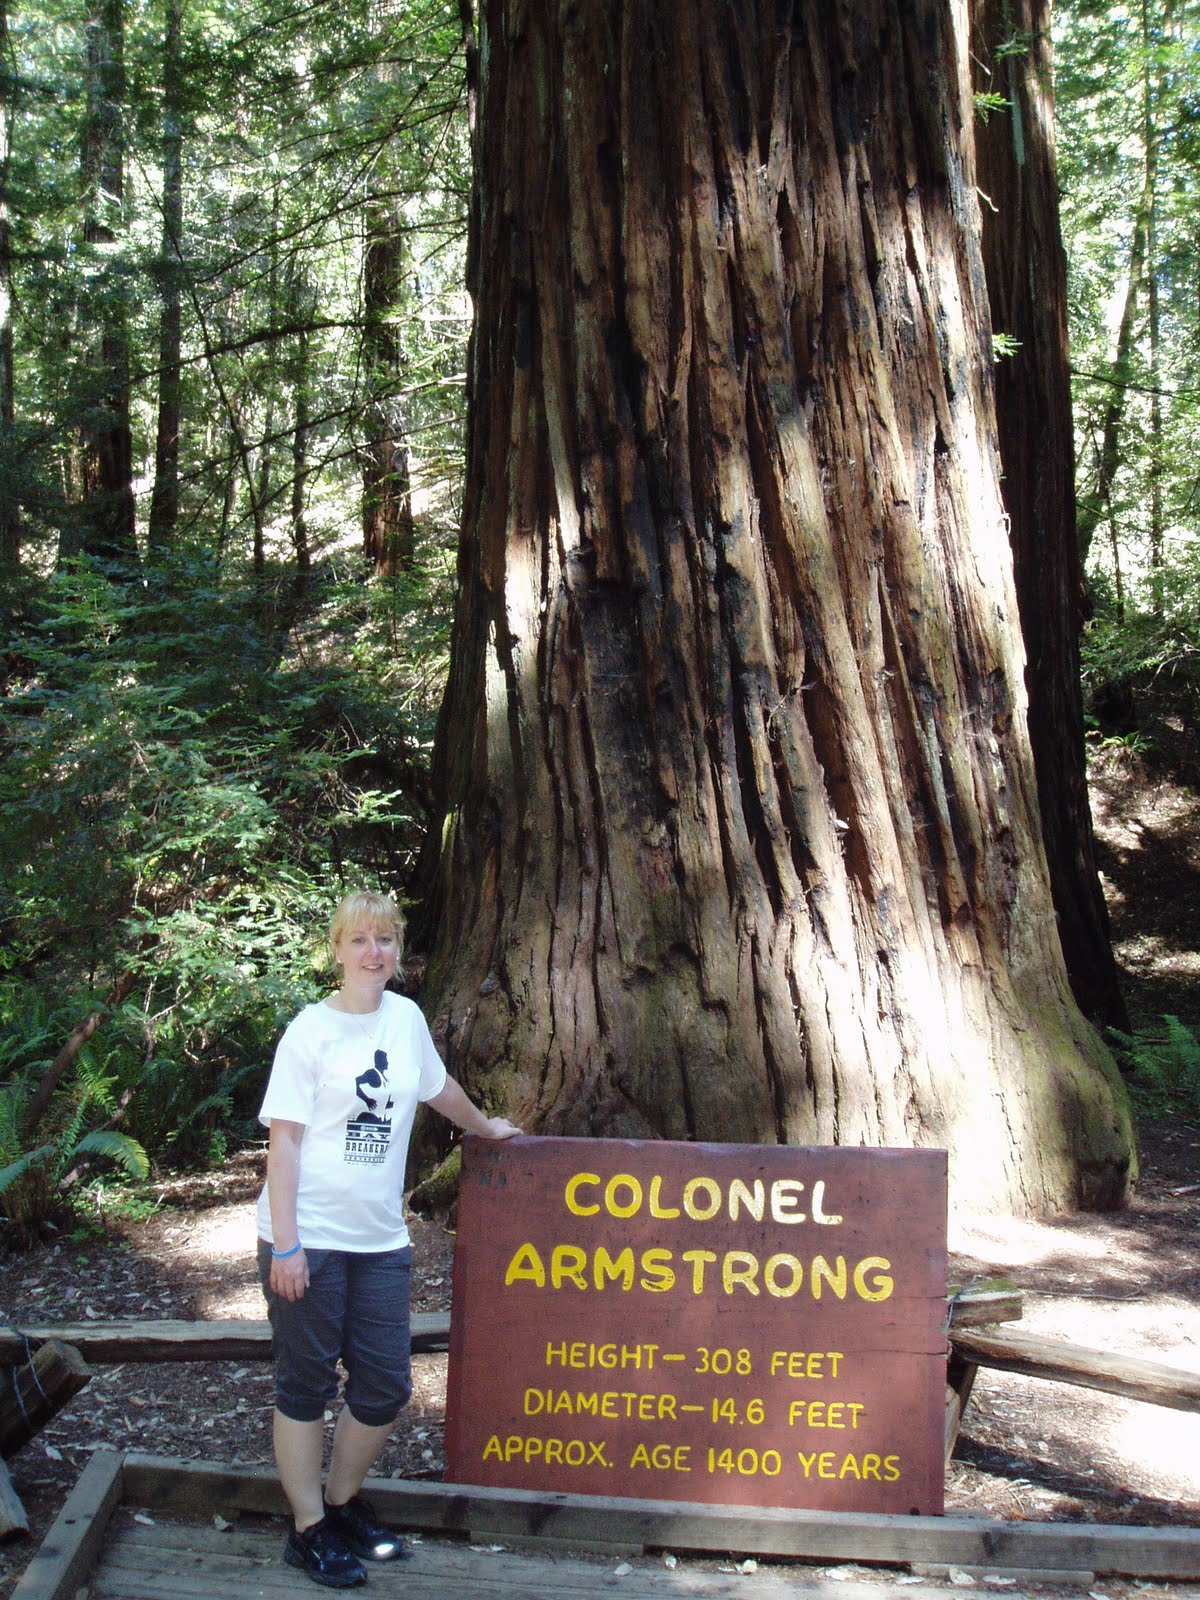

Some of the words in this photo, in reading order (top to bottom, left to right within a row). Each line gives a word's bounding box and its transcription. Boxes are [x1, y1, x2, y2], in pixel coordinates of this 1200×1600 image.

[565, 1173, 844, 1226] COLONEL
[505, 1243, 894, 1302] ARMSTRONG
[770, 1351, 845, 1379] FEET
[788, 1400, 865, 1430] FEET
[482, 1435, 615, 1468] APPROX.
[629, 1443, 692, 1473] AGE
[707, 1447, 784, 1477] 1400
[798, 1451, 903, 1482] YEARS
